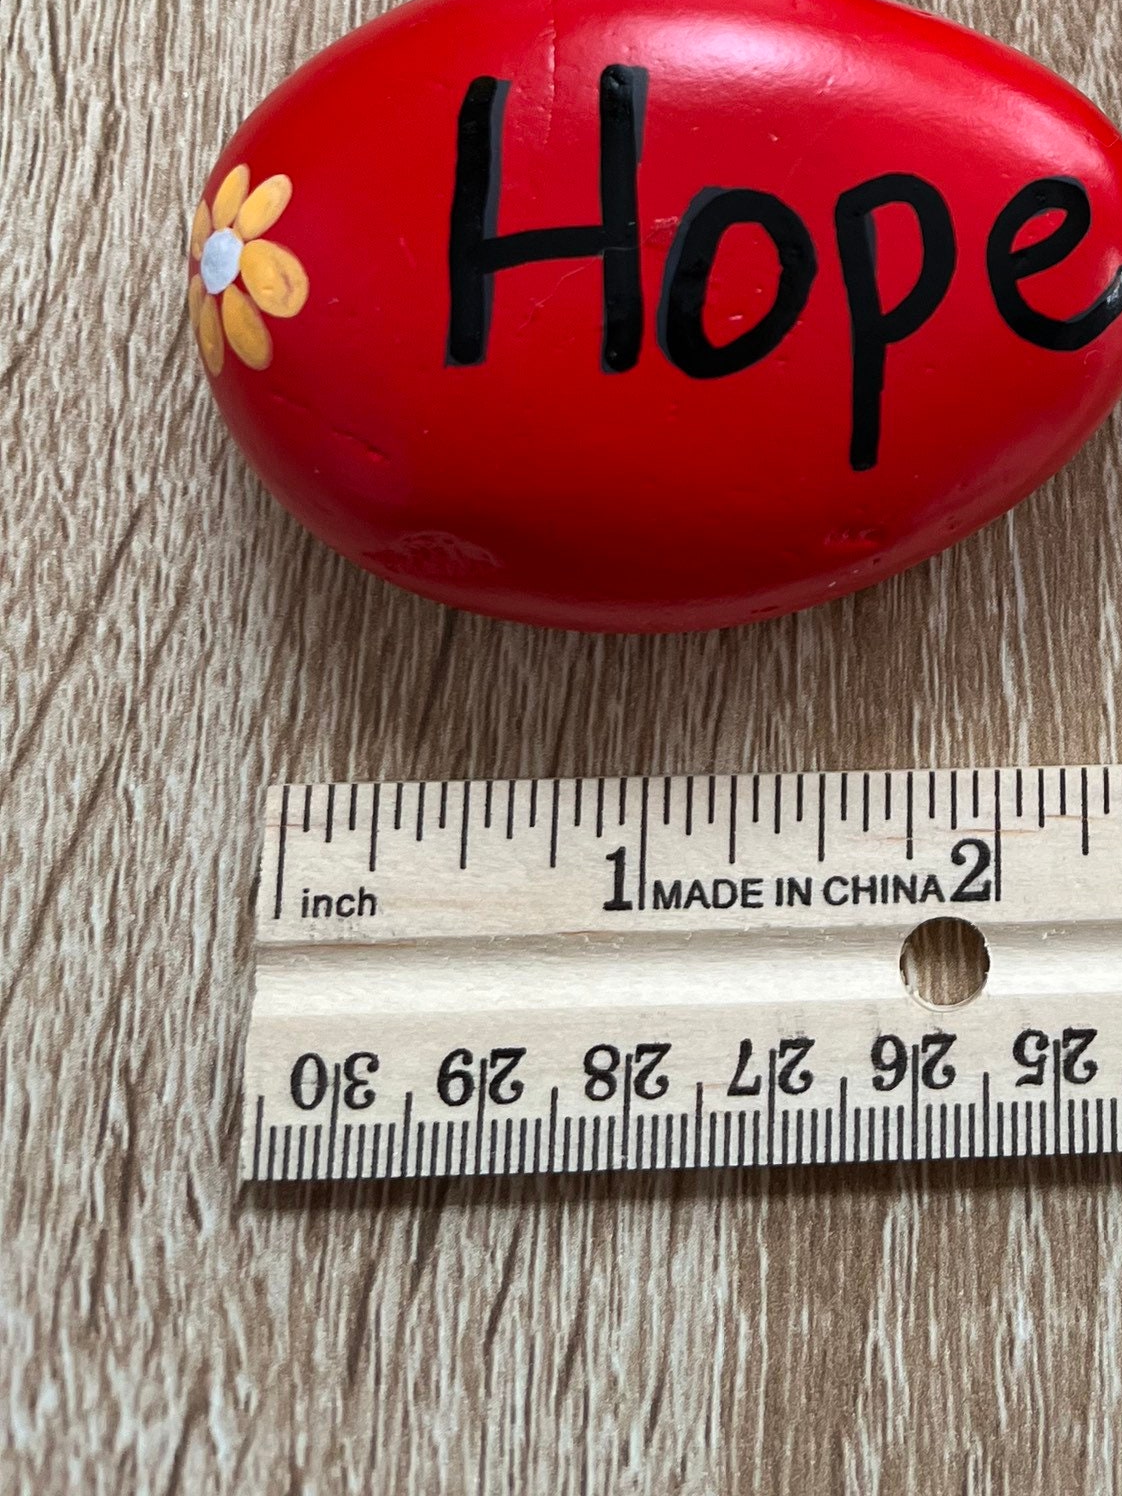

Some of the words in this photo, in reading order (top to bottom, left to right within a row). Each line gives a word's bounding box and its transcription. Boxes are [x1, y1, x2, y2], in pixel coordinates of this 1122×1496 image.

[603, 847, 632, 911] 1
[653, 879, 763, 909] MADE
[776, 878, 811, 906] IN
[823, 875, 945, 905] CHINA
[950, 839, 991, 902] 2
[302, 887, 376, 918] inch
[291, 1052, 378, 1111] 30
[437, 1048, 526, 1108] 29
[584, 1044, 671, 1103] 28
[727, 1037, 814, 1097] 27
[871, 1032, 957, 1092] 26
[1013, 1028, 1097, 1087] 25
